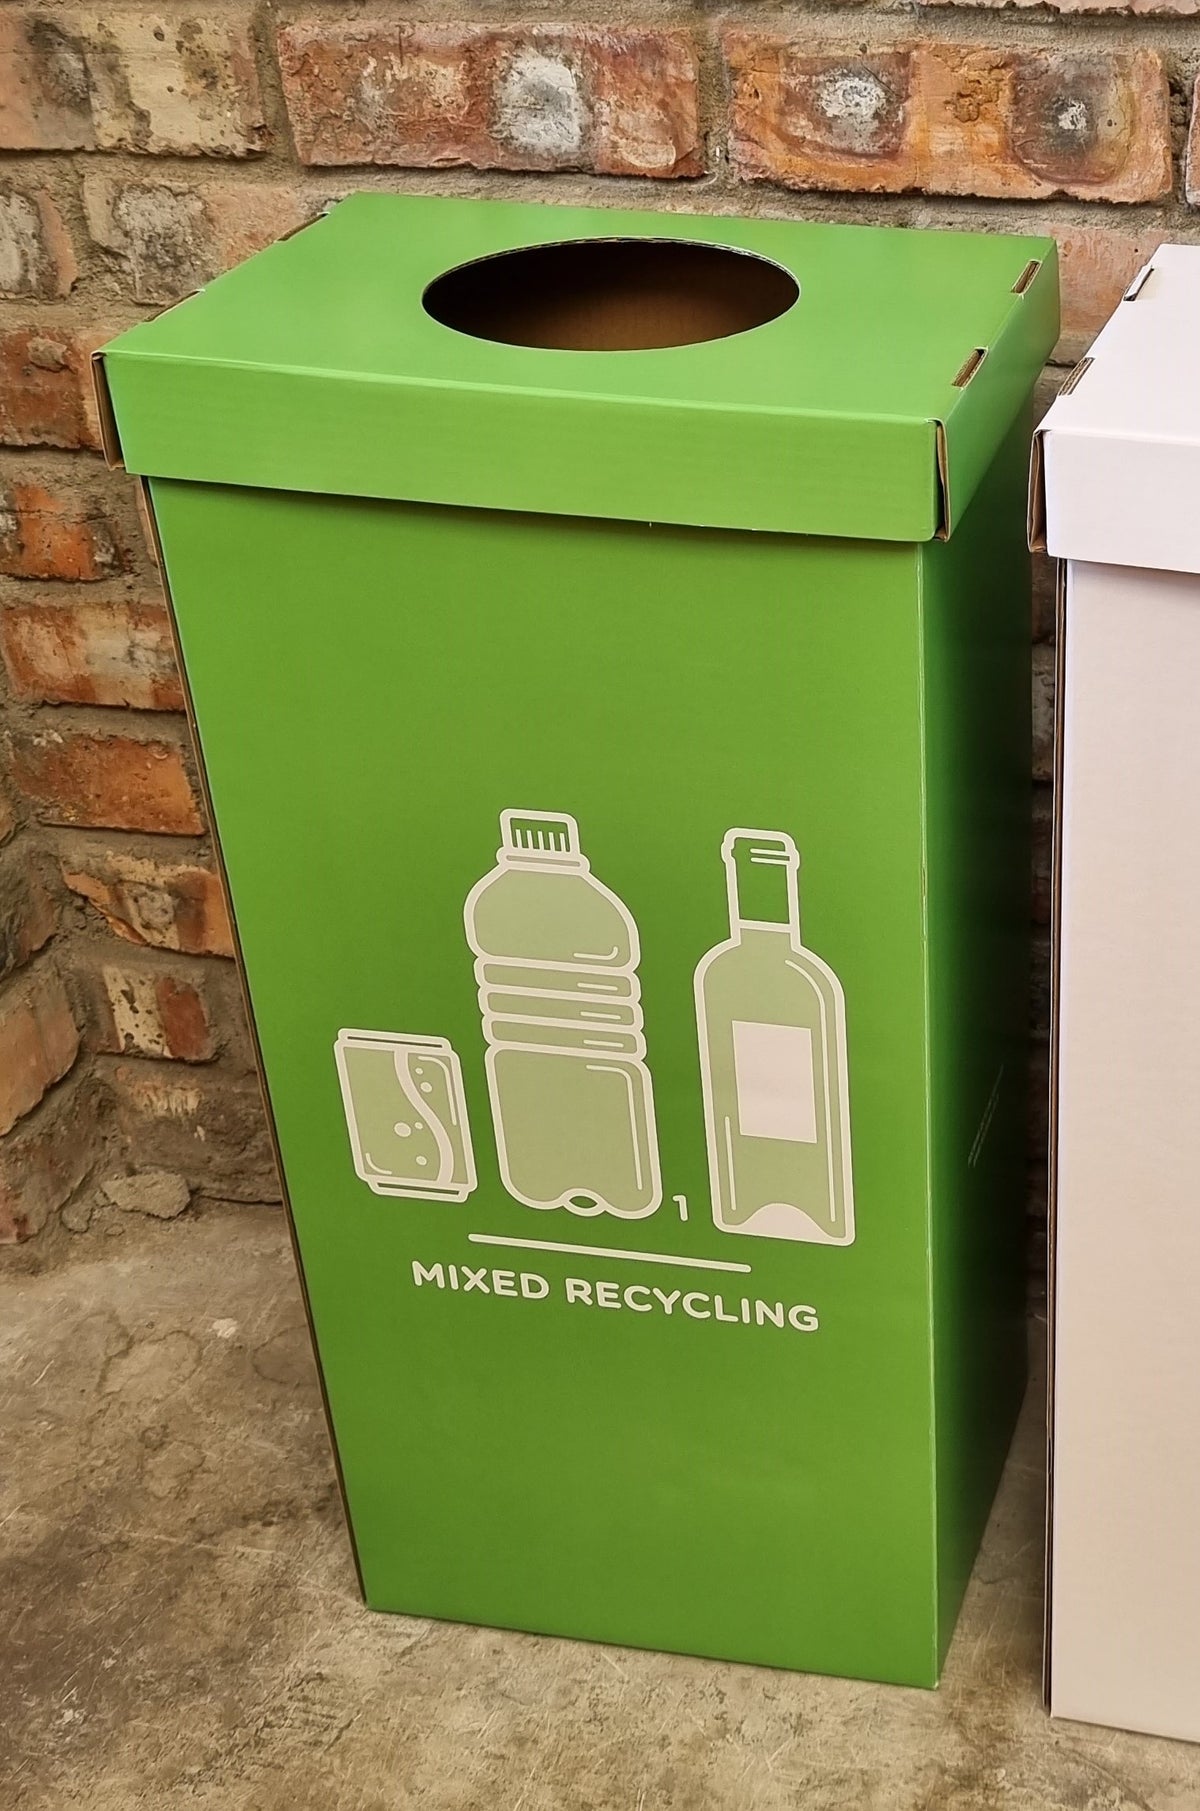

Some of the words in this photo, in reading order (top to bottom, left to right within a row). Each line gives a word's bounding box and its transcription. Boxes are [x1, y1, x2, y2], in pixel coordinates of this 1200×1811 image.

[672, 1194, 689, 1222] 1
[411, 1260, 550, 1299] MIXED
[565, 1277, 819, 1332] RECYCLING
